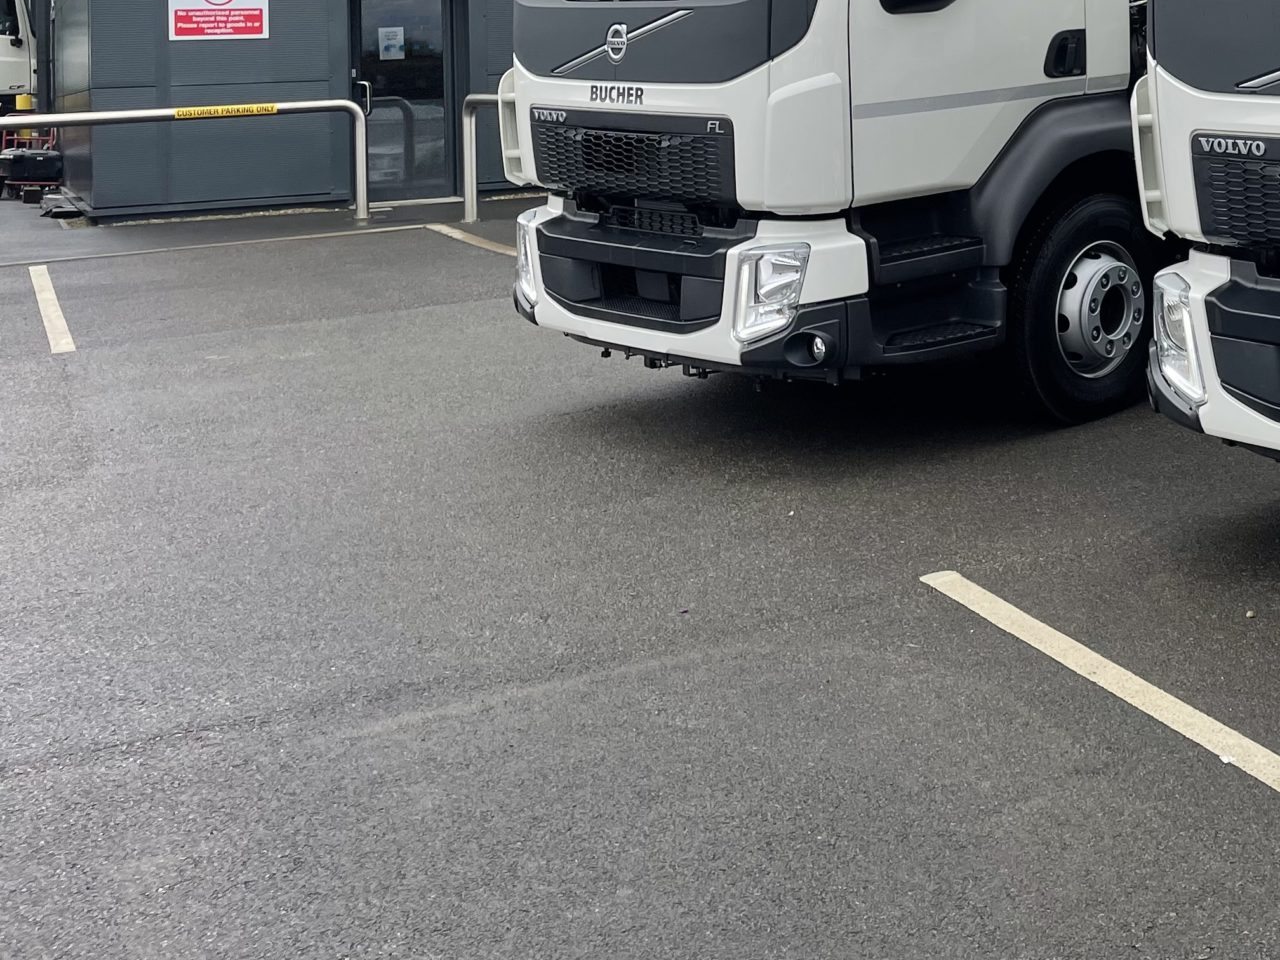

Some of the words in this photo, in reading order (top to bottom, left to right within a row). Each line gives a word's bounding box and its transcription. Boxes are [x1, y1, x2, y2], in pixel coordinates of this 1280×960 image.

[589, 85, 644, 105] BUCHER
[177, 108, 219, 117] CUSTOMER
[221, 106, 254, 115] PARKING
[256, 105, 275, 113] ONLY
[533, 110, 567, 123] VOLVO
[707, 121, 724, 133] FL
[1198, 137, 1266, 157] VOLVO
